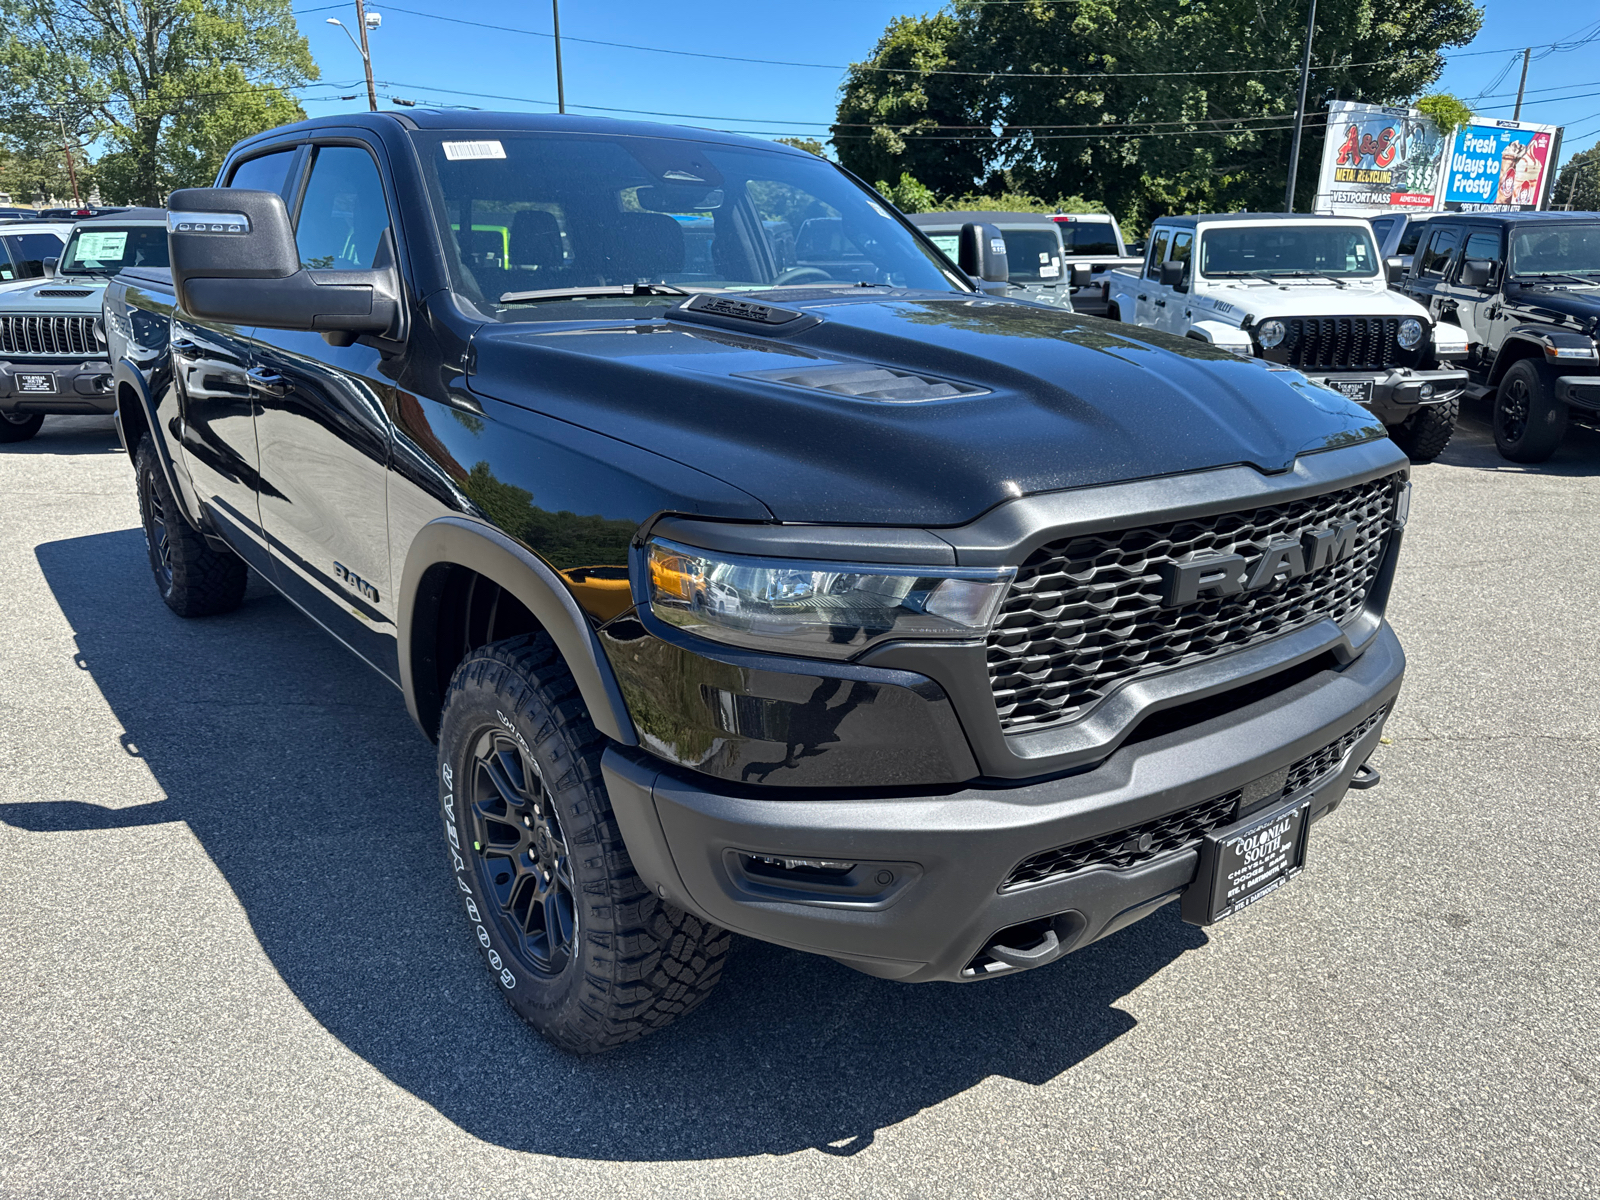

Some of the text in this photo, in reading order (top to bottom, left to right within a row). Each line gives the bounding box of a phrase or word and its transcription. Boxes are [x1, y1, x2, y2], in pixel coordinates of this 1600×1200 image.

[1336, 124, 1396, 168] A&E
[1464, 133, 1497, 154] Fresh
[1336, 168, 1392, 184] METAL RECYCLING
[1452, 153, 1500, 178] Ways to
[1371, 193, 1391, 204] MASS
[1399, 195, 1431, 204] AEMETALS.COM
[1453, 174, 1493, 199] Frosty
[708, 297, 772, 316] 1500
[1164, 520, 1357, 606] RAM
[333, 560, 380, 603] RAM
[1235, 819, 1290, 856] COLONIAL
[1243, 835, 1282, 866] SOUTH
[443, 763, 516, 989] GOODYEAR
[1228, 853, 1276, 880] CHRYSLER
[1233, 853, 1285, 886] DODGE RAM
